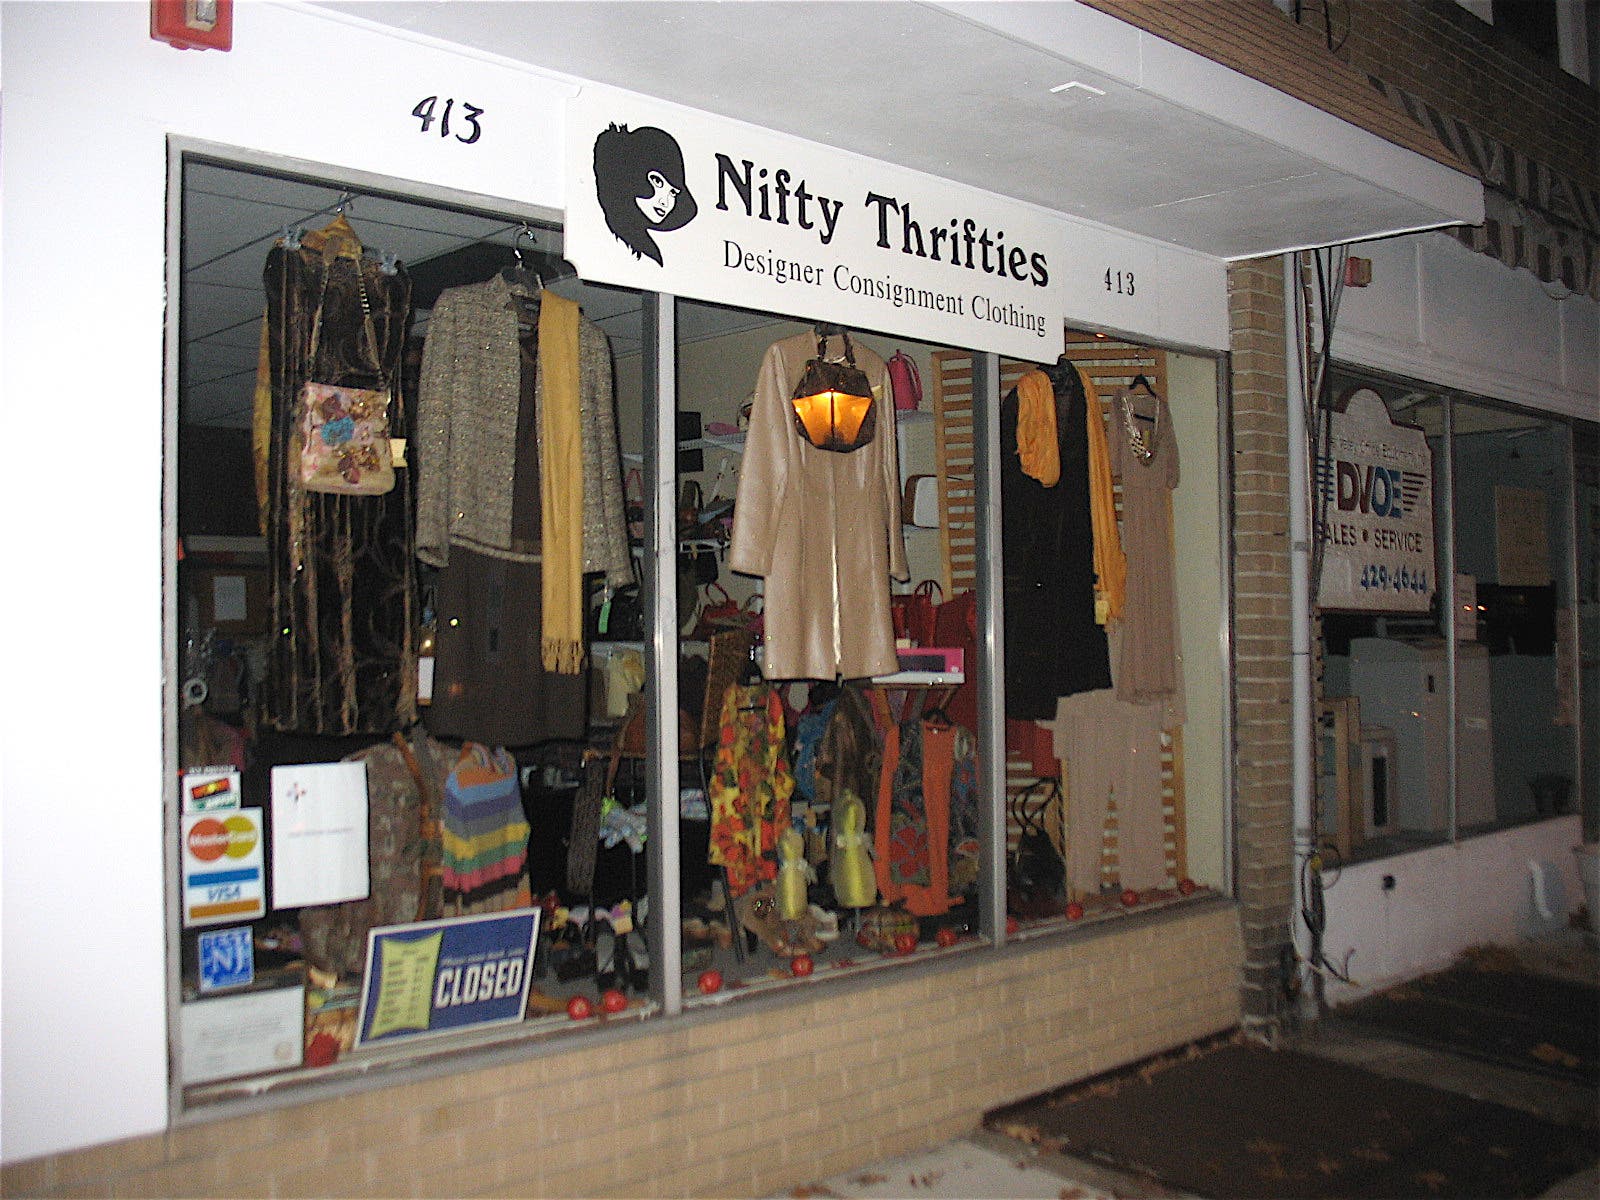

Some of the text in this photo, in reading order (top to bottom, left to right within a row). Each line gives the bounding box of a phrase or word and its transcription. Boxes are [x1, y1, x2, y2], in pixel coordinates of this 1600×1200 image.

[411, 95, 485, 145] 413
[714, 152, 1050, 288] Nifty Thrifties
[723, 239, 1047, 338] Designer Consignment Clothing
[1104, 266, 1135, 297] 413
[1337, 460, 1402, 519] DVOE
[1315, 521, 1423, 552] ALES SERVICE
[207, 887, 241, 901] VISA
[434, 959, 525, 1009] CLOSED
